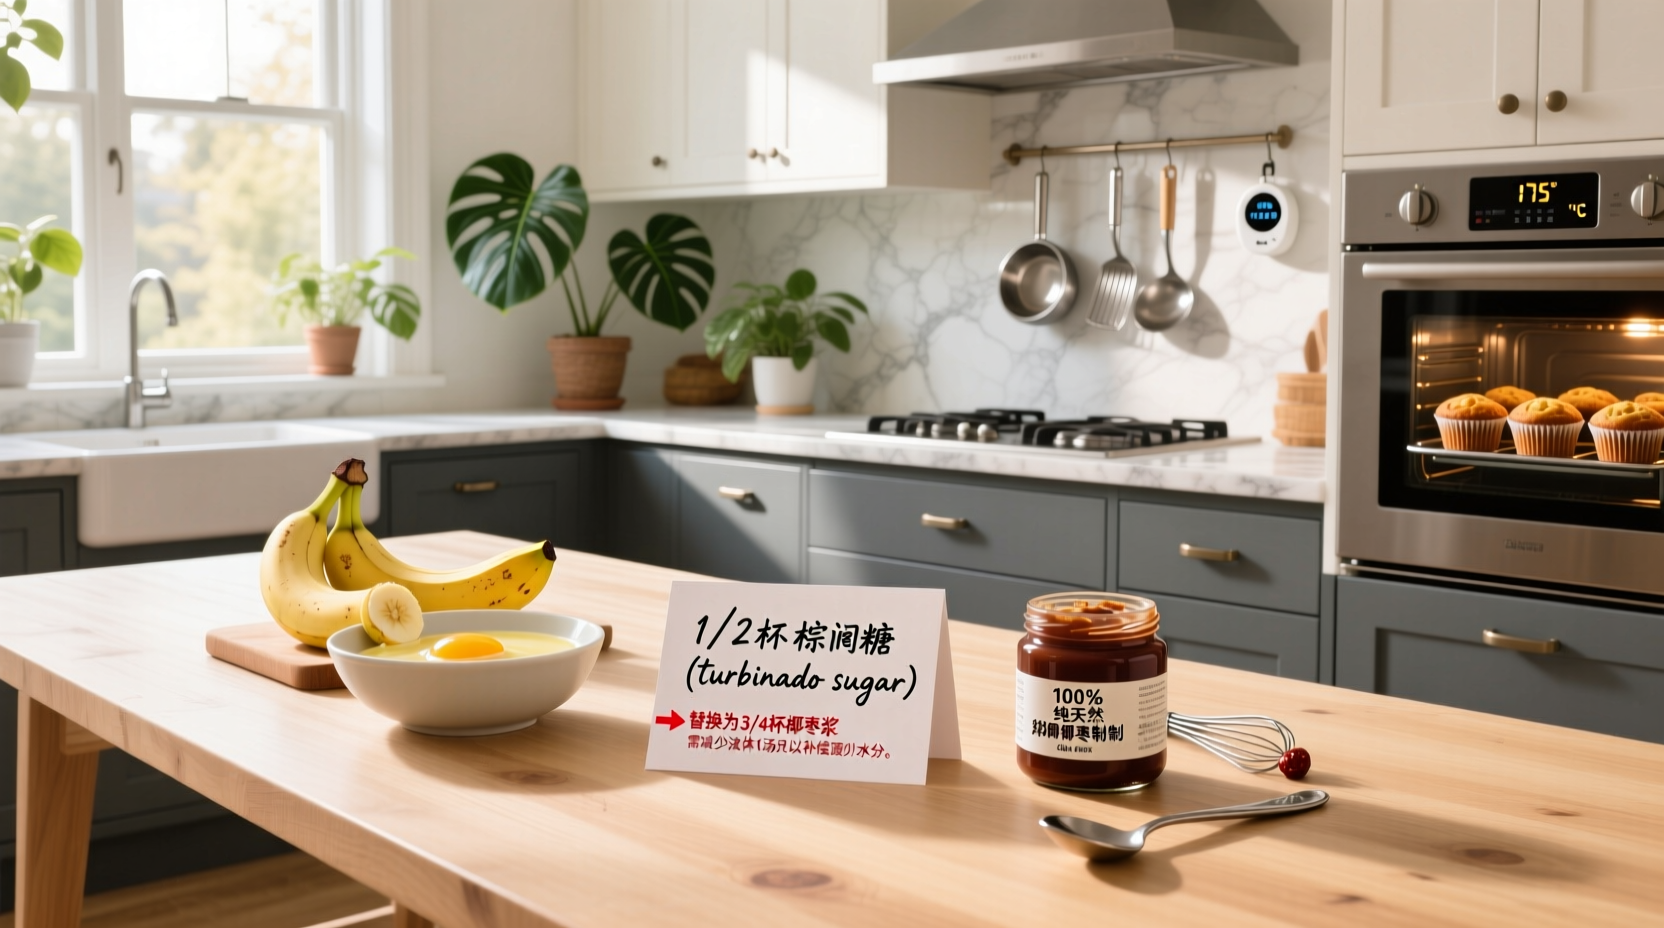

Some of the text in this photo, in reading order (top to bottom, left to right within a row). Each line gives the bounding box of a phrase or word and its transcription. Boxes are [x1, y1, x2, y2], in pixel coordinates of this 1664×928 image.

[686, 655, 917, 707] (turbinado sugar)
[1052, 687, 1104, 706] 100%
[1052, 705, 1105, 723] 纯天然
